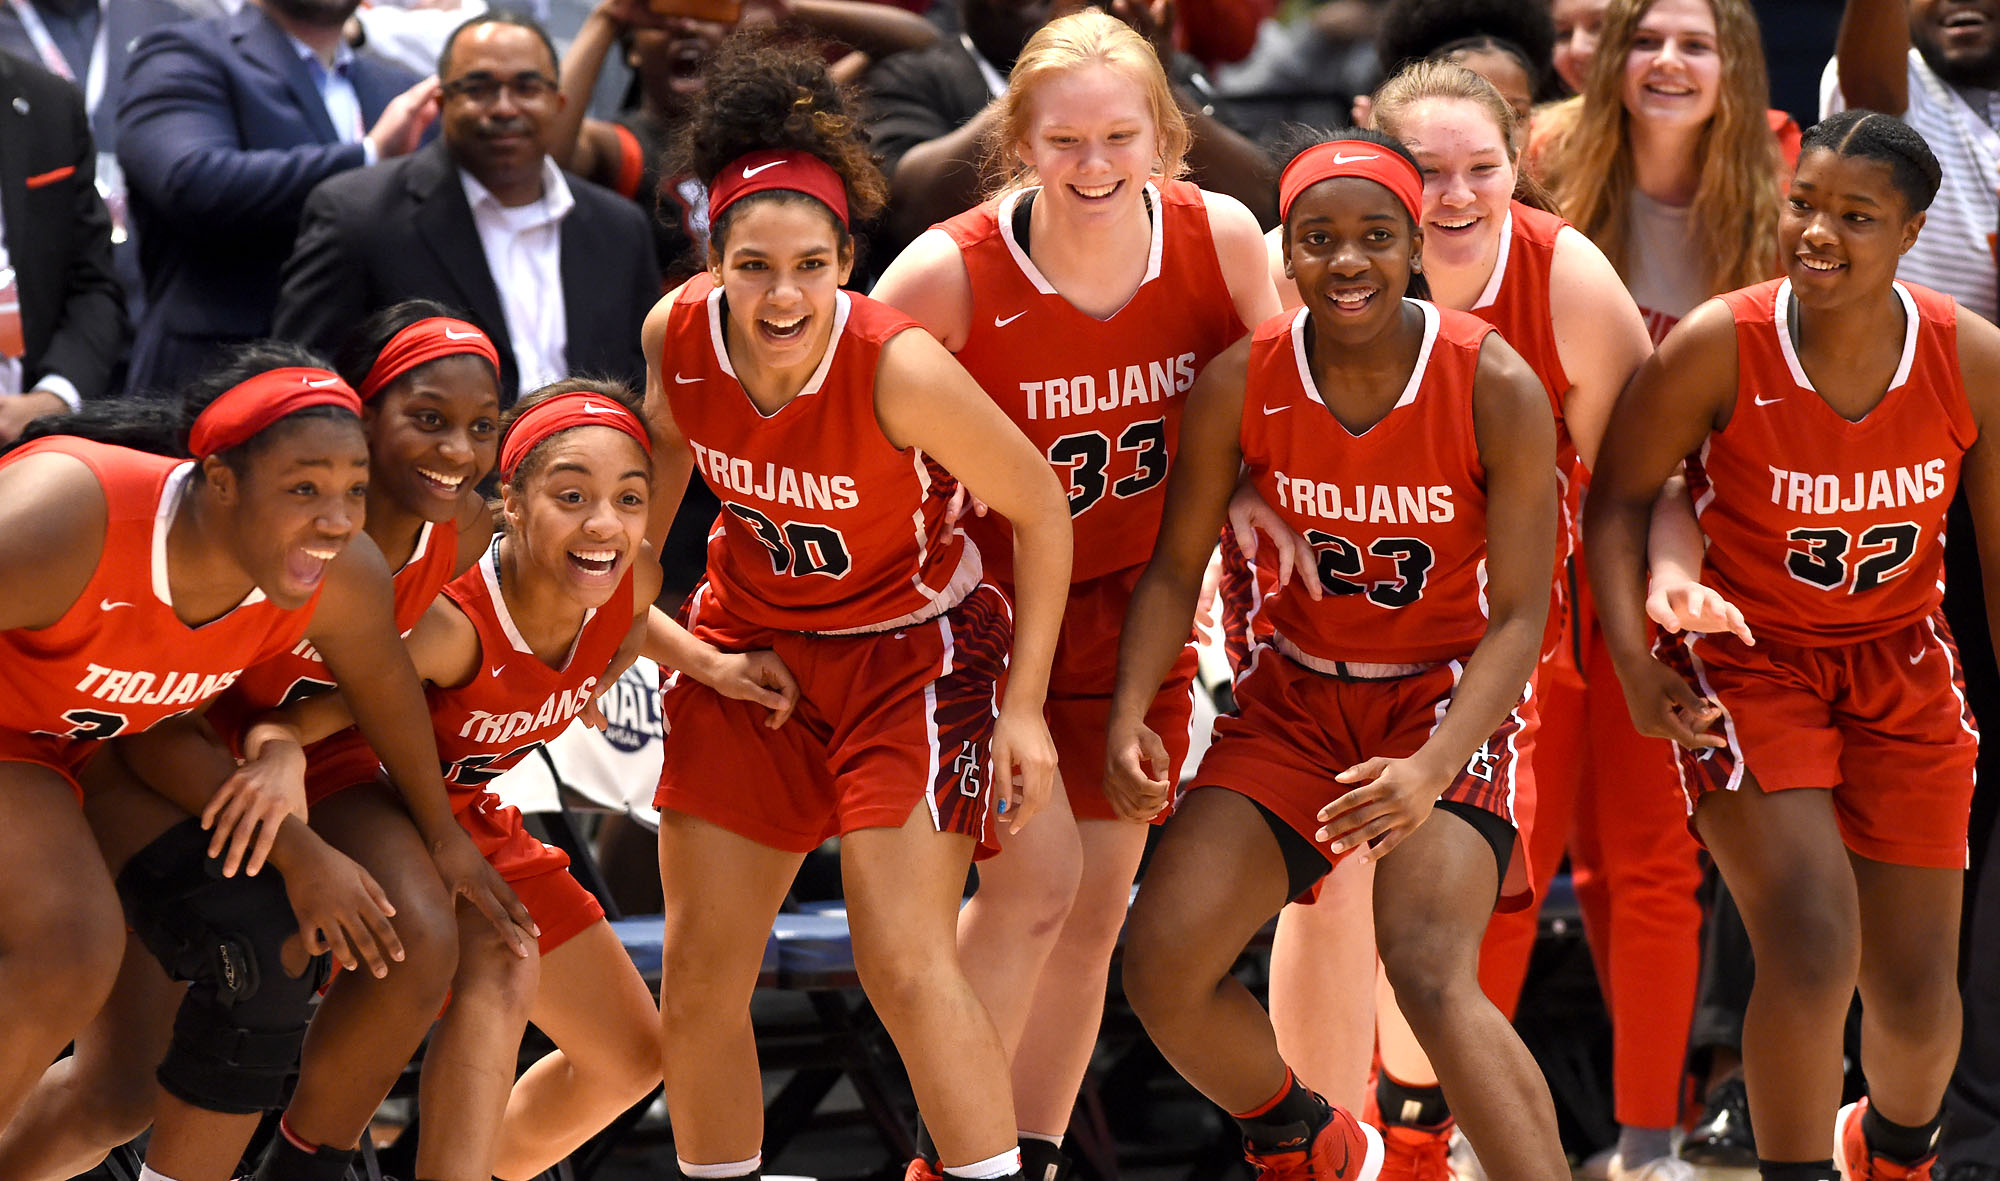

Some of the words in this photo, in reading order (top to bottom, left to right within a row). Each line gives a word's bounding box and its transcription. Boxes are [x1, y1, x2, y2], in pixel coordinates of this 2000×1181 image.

[1019, 352, 1196, 420] TROJANS
[689, 438, 860, 511] TROJANS
[1047, 416, 1169, 520] 33
[1274, 471, 1455, 524] TROJANS
[1768, 458, 1946, 515] TROJANS
[724, 500, 853, 581] 30
[1302, 528, 1436, 610] 23
[1784, 521, 1922, 596] 32
[75, 662, 244, 706] TROJANS
[458, 675, 598, 744] TROJANS
[596, 681, 663, 740] NALS
